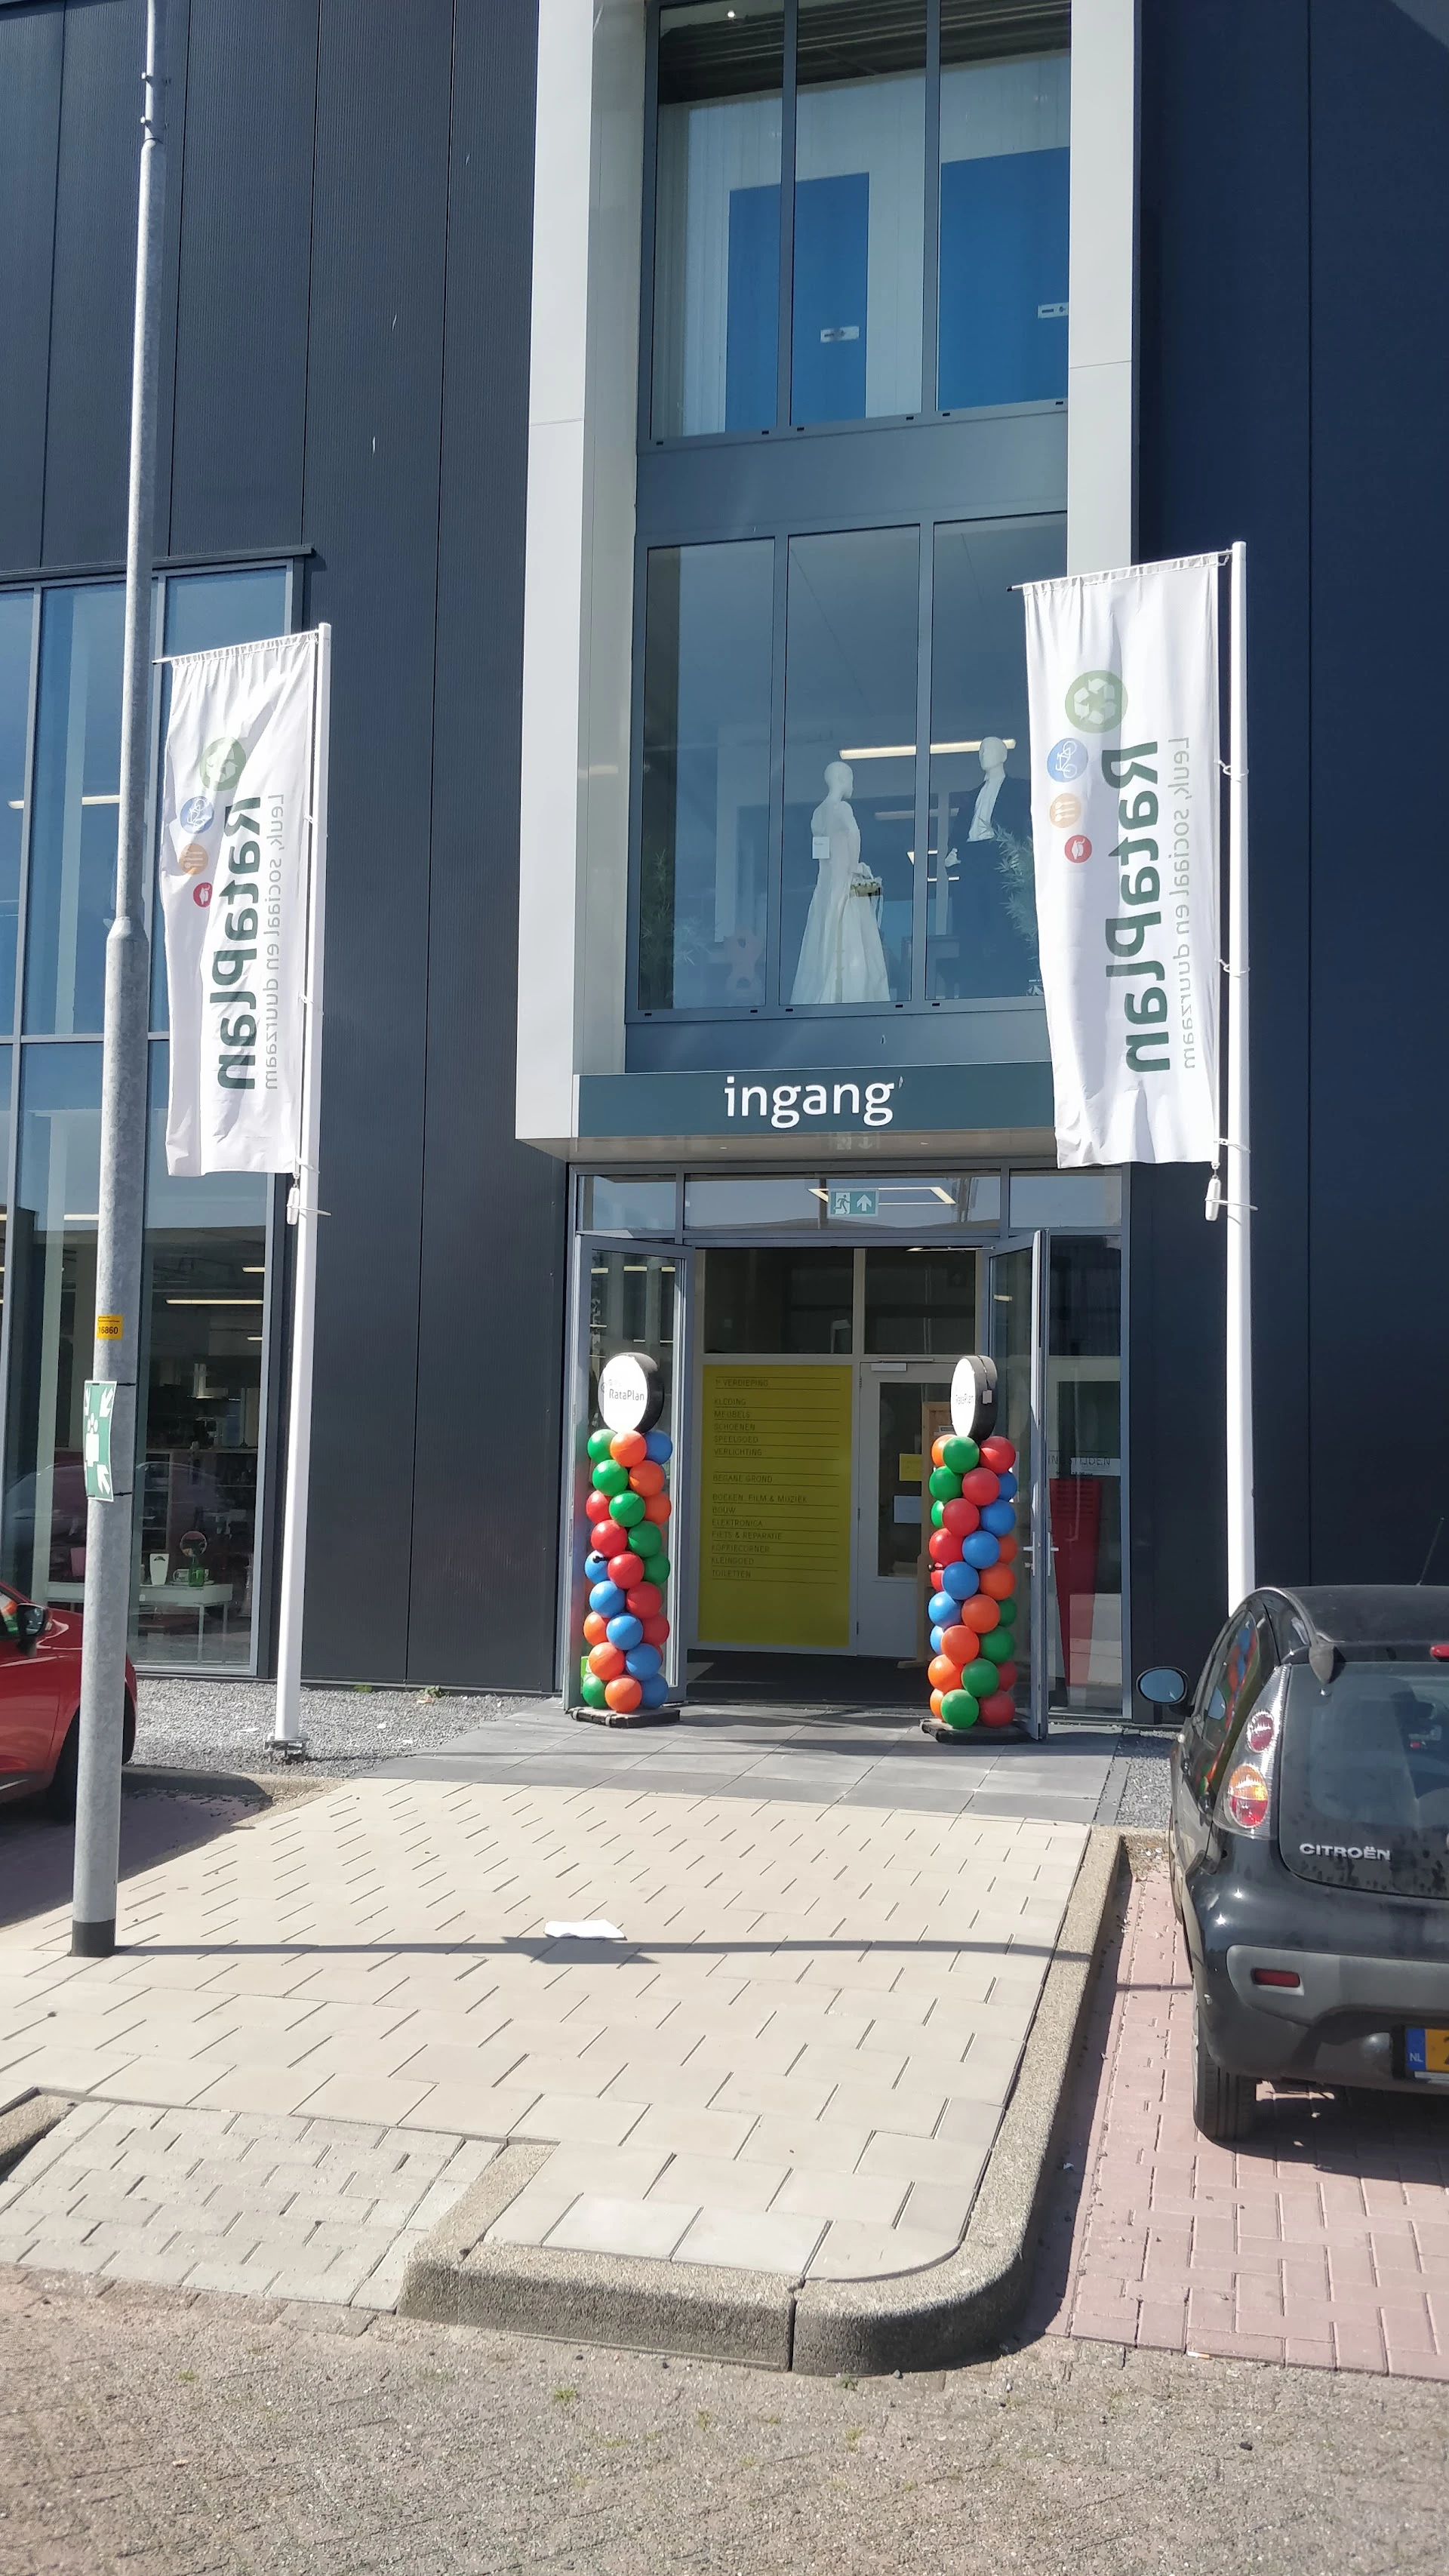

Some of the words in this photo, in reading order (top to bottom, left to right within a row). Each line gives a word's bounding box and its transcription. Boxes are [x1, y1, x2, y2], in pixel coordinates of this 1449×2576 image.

[724, 1076, 895, 1129] ingang
[724, 1378, 769, 1386] VERDIEPING
[609, 1388, 645, 1401] RataPlan
[714, 1397, 746, 1405] KLEDING
[714, 1410, 751, 1419] MEUBELS
[714, 1423, 755, 1431] SCHOENEN
[714, 1435, 759, 1443] SPEELGOED
[714, 1448, 762, 1456] VERLICHTING
[712, 1473, 743, 1482] BEGANE
[746, 1475, 773, 1483] GROND
[777, 1495, 808, 1503] MUZIEK
[712, 1506, 737, 1514] BOUW
[712, 1518, 763, 1528] ELEKTRONICA
[712, 1531, 733, 1539] FIETS
[743, 1531, 782, 1540] REPARATIE
[711, 1544, 771, 1553] KOFFIECORNER
[711, 1556, 755, 1565] KLEINGOED
[712, 1569, 751, 1578] TOILETTEN
[1299, 1843, 1392, 1860] CITROËN
[1409, 2052, 1424, 2063] NL
